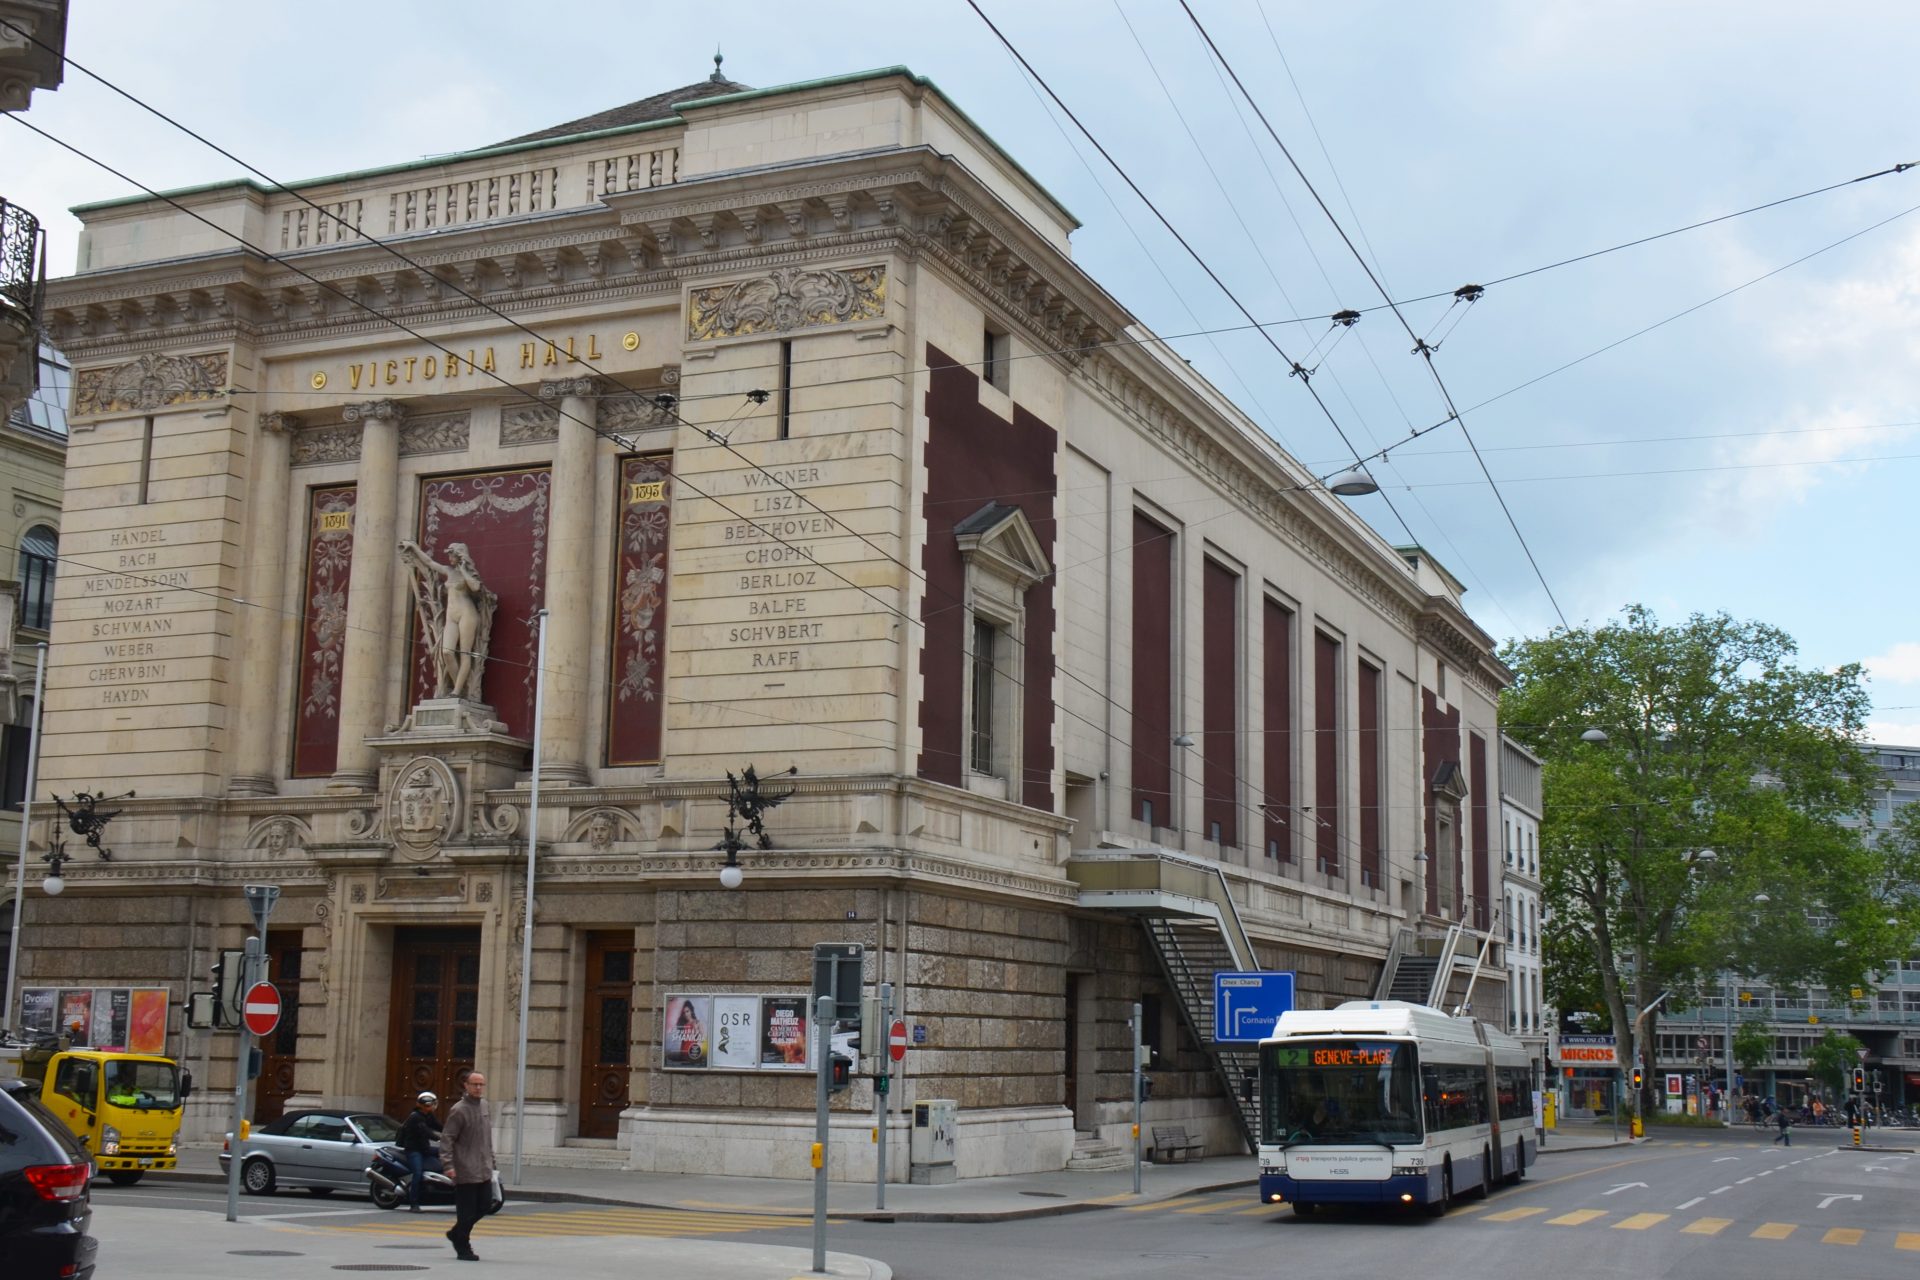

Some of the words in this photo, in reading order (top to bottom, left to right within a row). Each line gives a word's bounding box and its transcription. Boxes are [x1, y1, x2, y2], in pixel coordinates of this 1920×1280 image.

[350, 347, 496, 389] VICTORIA
[520, 334, 602, 369] HALL
[744, 468, 819, 487] WAGNER
[636, 485, 660, 499] 1893
[753, 495, 807, 512] LISZT
[325, 514, 346, 528] 1891
[725, 519, 835, 540] BEETHOVEN
[119, 552, 157, 567] BACH
[745, 545, 814, 563] CHOPIN
[85, 572, 189, 592] MENDELSSOHN
[741, 572, 816, 590] BERLIOZ
[104, 597, 164, 613] MOZART
[749, 598, 806, 615] BALFE
[92, 618, 172, 636] SCHVMANN
[729, 623, 823, 642] SCHVBERT
[104, 643, 154, 657] WEBER
[752, 651, 799, 667] RAFF
[88, 665, 166, 681] CHERVBINI
[103, 688, 150, 703] HAYDN
[1240, 979, 1260, 987] Chancy
[721, 1012, 751, 1026] OSR
[775, 1009, 795, 1018] DIEGO
[1241, 1016, 1275, 1024] Cornavin
[1287, 1049, 1299, 1065] 2
[1314, 1049, 1392, 1065] GENEVE-PLAGE
[1560, 1047, 1614, 1061] MIGROS
[1410, 1157, 1424, 1166] 739
